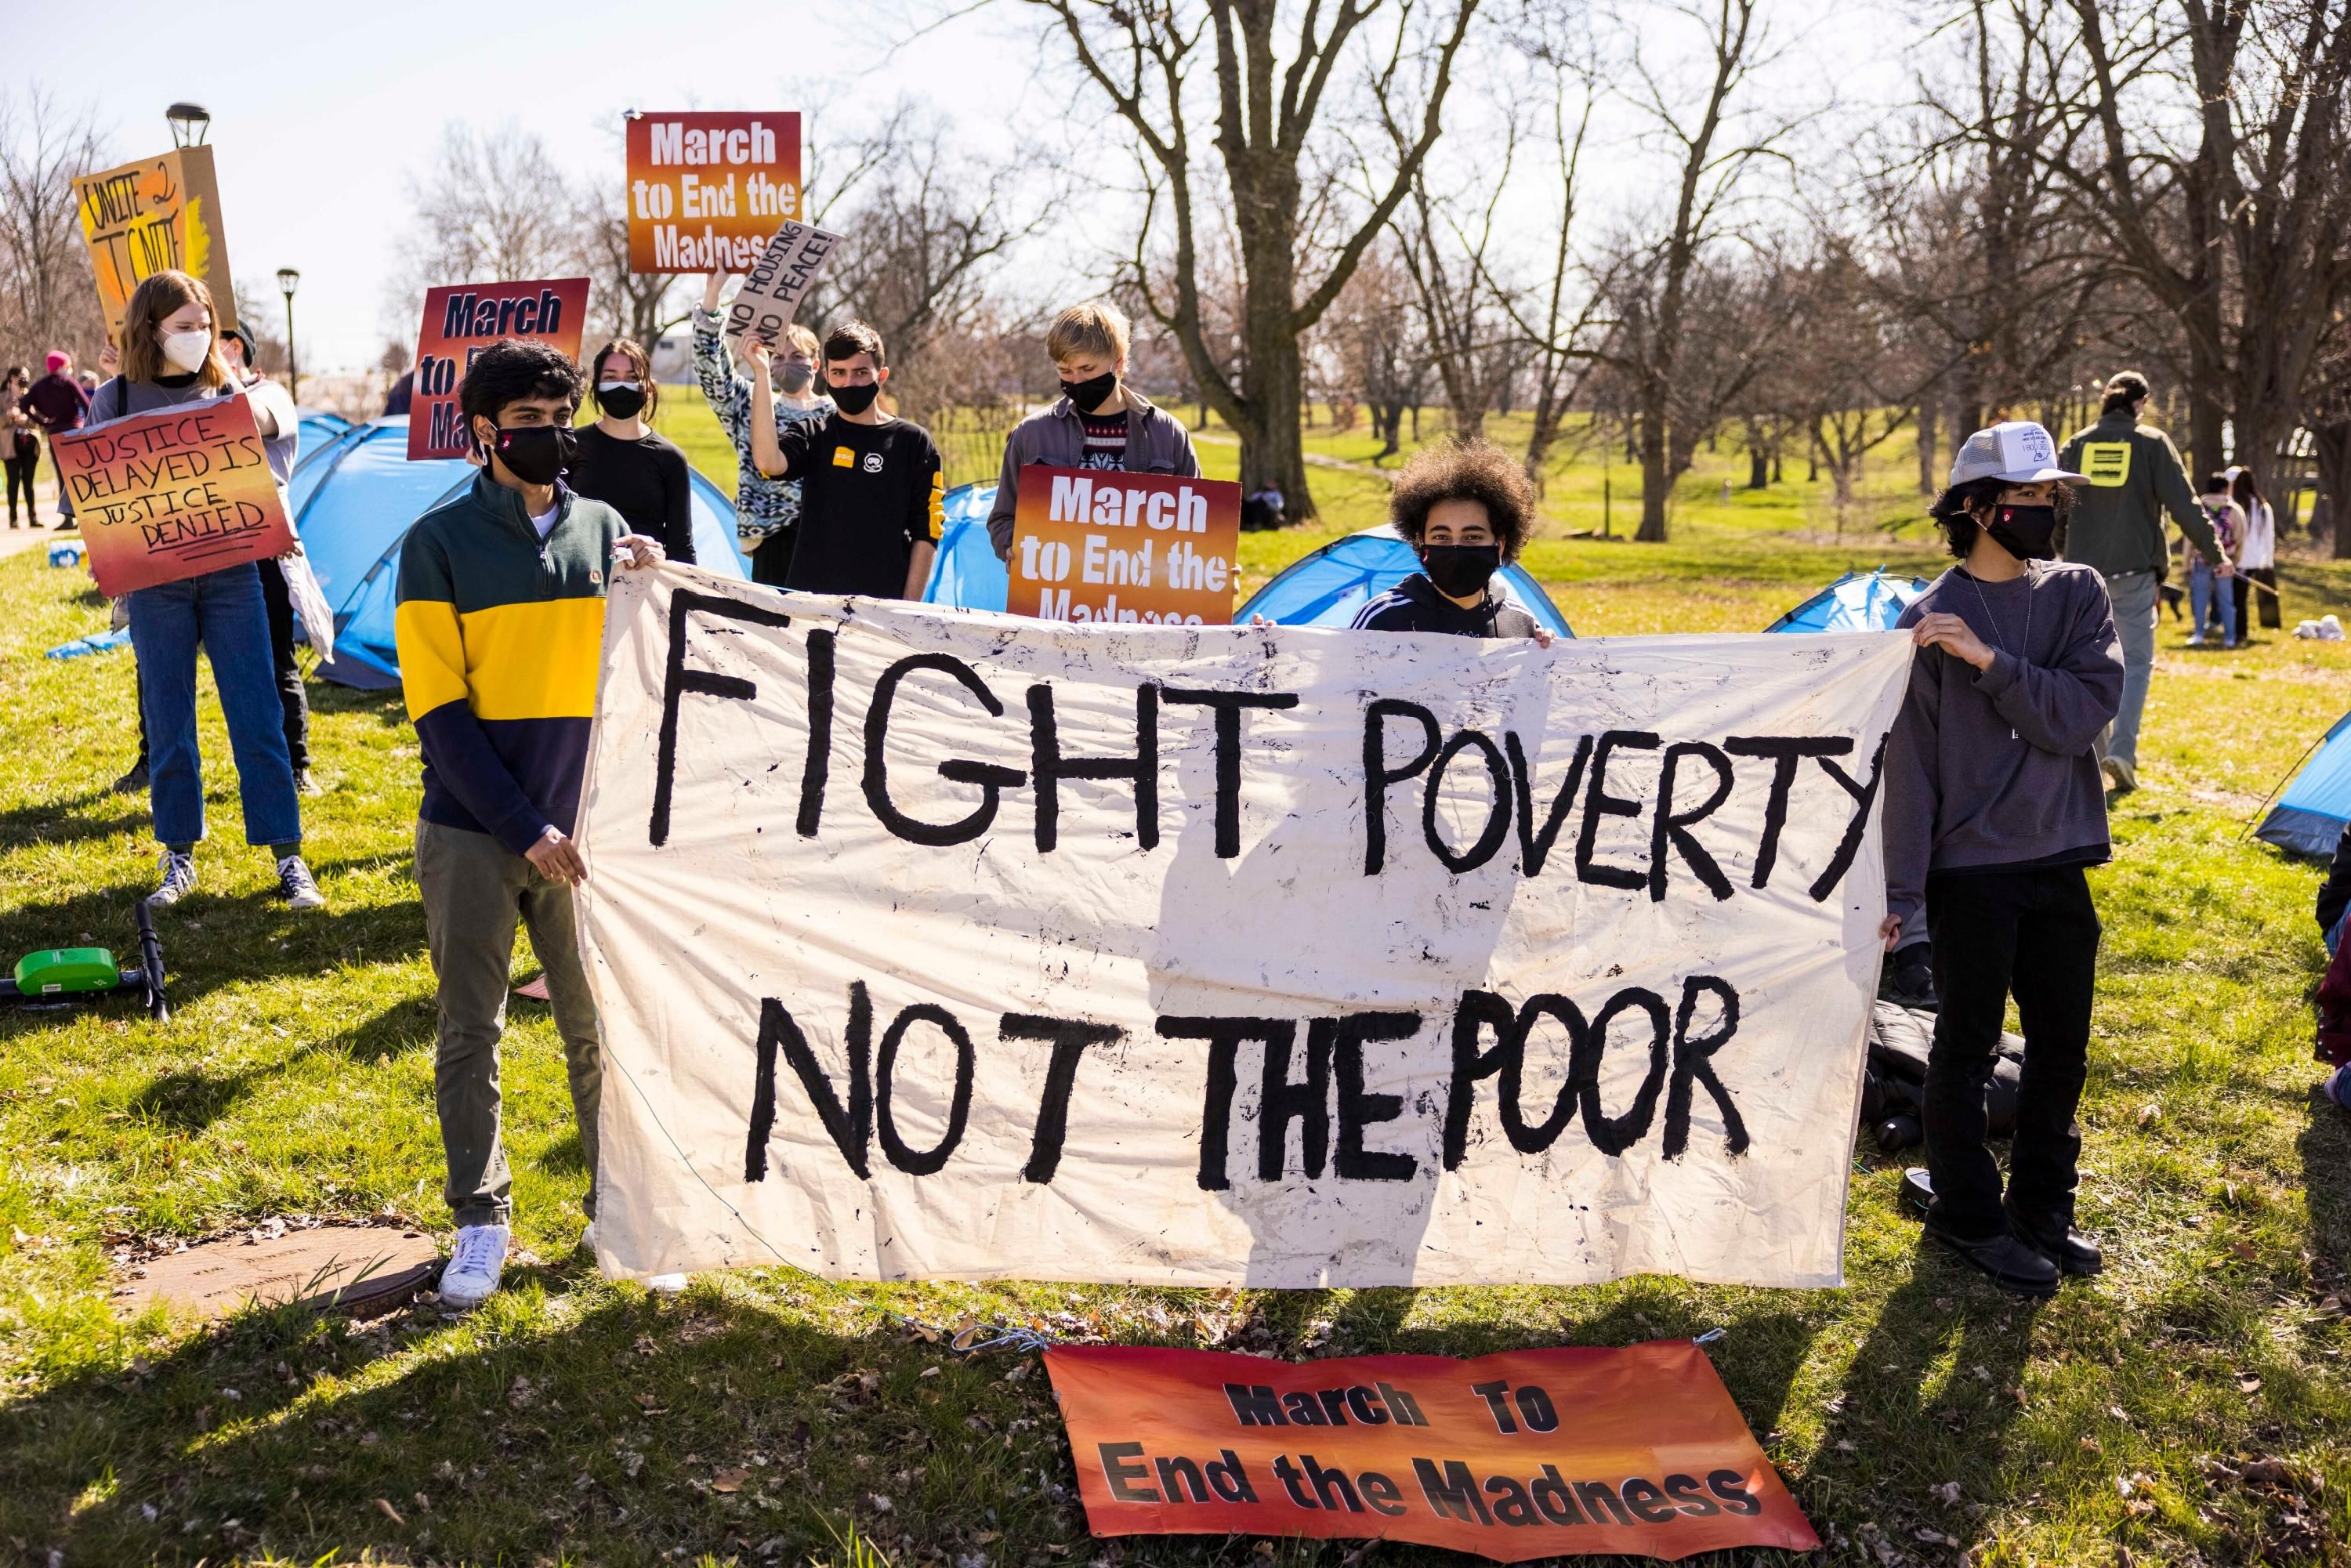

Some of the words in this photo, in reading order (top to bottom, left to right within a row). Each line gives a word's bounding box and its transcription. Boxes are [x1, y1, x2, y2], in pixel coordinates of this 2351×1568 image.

[650, 121, 777, 166] March
[83, 170, 143, 230] UNITE
[153, 161, 176, 205] 2
[632, 179, 673, 220] to
[682, 173, 737, 218] End
[746, 172, 797, 216] the
[653, 225, 774, 269] Madnes
[726, 303, 755, 338] NO
[744, 223, 803, 295] HOUSING
[755, 313, 783, 347] NO
[773, 232, 833, 302] PEACE!
[443, 288, 563, 339] March
[420, 353, 456, 396] to
[60, 415, 226, 469] JUSTICE
[70, 451, 210, 503] DELAYED
[212, 436, 261, 472] IS
[82, 483, 226, 526] JUSTICE
[141, 501, 265, 549] DENIED
[1049, 476, 1208, 534] March
[1020, 535, 1070, 582] to
[1082, 534, 1153, 588] End
[1167, 541, 1227, 592] the
[649, 588, 1296, 859] FIGHT
[1363, 698, 1889, 903] POVERTY
[744, 980, 1125, 1184] NOT
[1155, 1010, 1422, 1191] THE
[1443, 976, 1751, 1172] POOR
[1222, 1382, 1430, 1427] March
[1471, 1380, 1559, 1435] To
[1098, 1441, 1259, 1505] End
[1272, 1454, 1408, 1516] the
[1411, 1457, 1764, 1526] Madness
